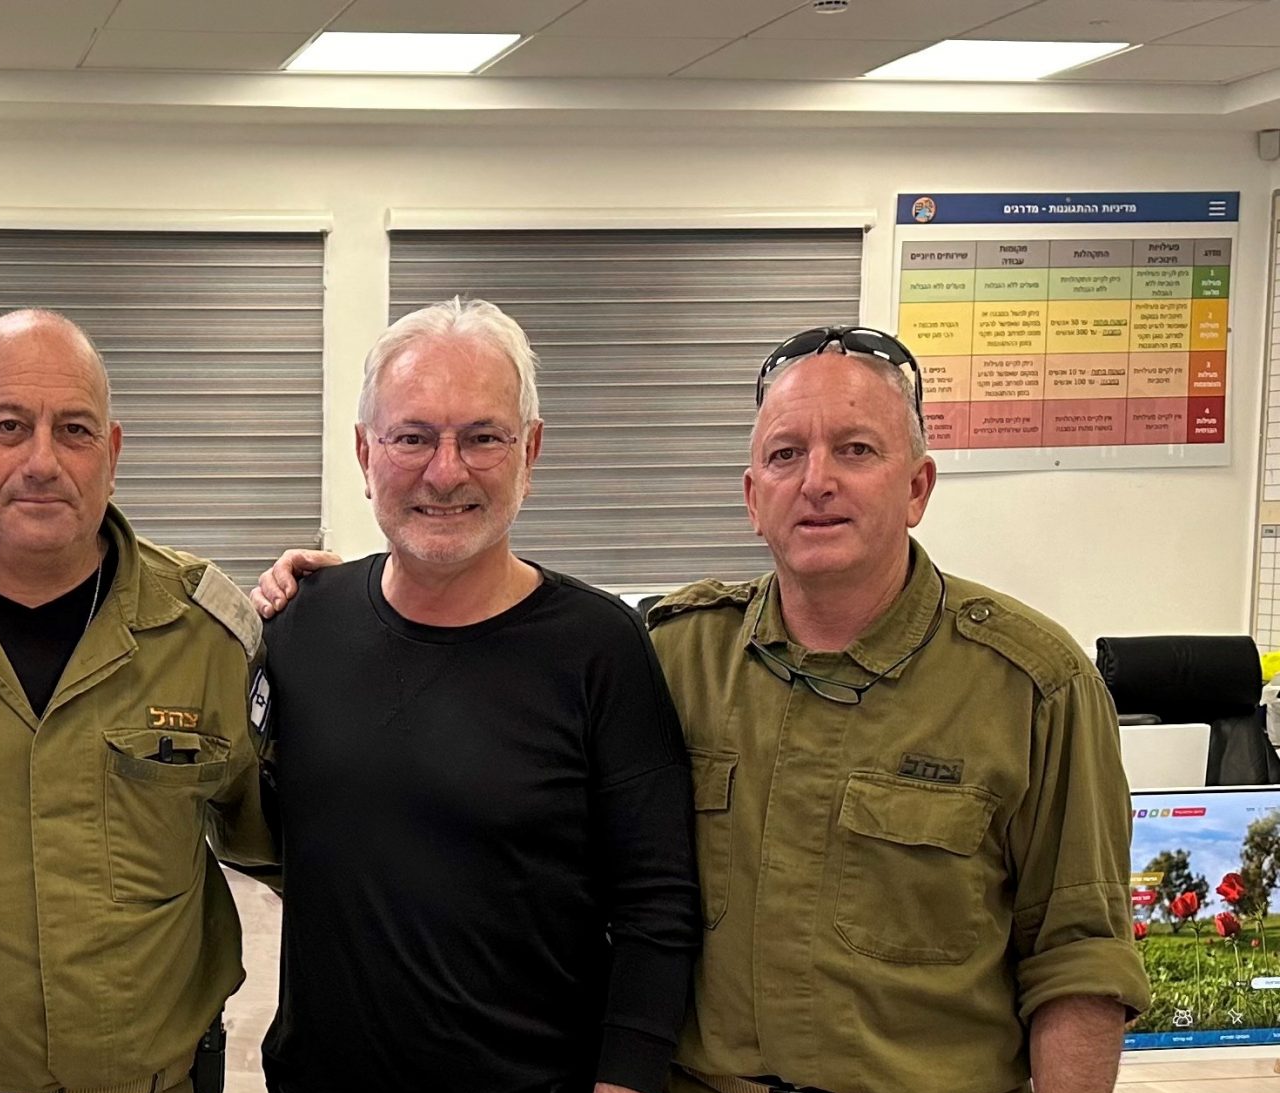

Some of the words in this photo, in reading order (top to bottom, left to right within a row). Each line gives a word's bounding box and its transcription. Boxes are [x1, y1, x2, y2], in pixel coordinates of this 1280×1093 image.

[1003, 205, 1039, 214] מדרגים
[1048, 204, 1098, 214] ההתגוננות
[1102, 204, 1137, 213] מדיניות
